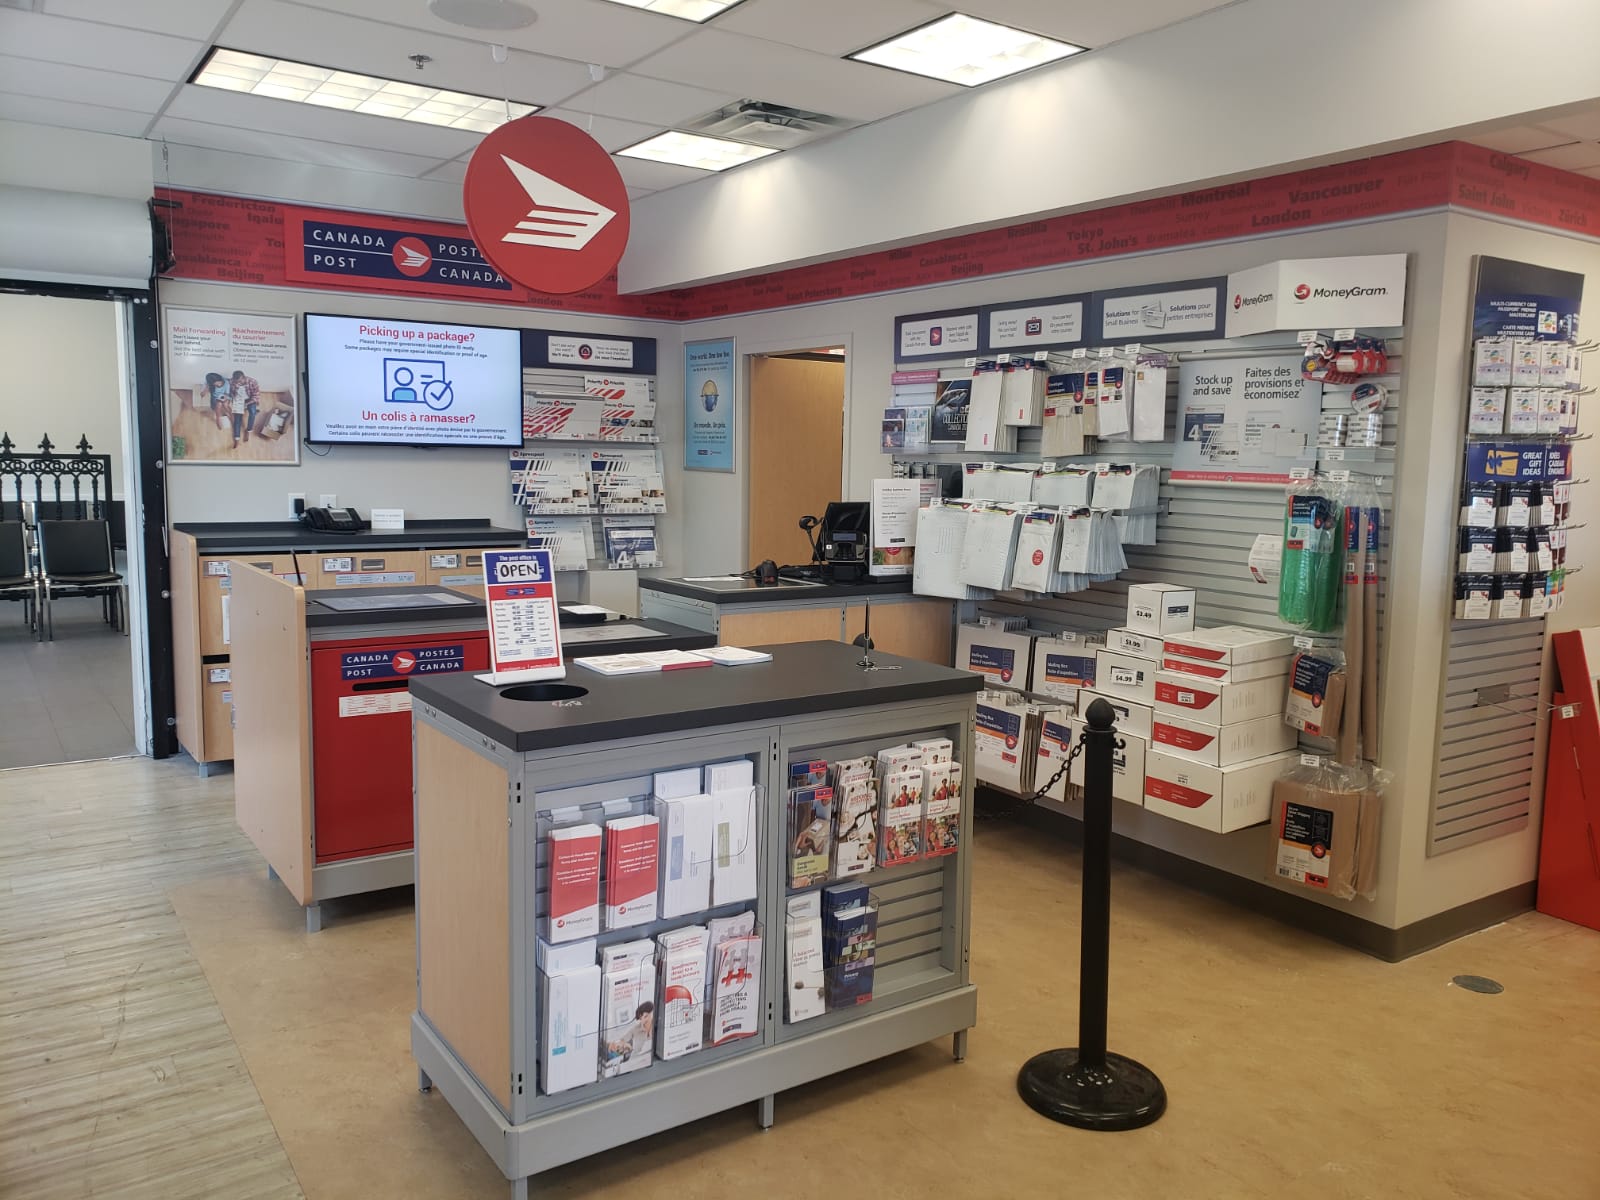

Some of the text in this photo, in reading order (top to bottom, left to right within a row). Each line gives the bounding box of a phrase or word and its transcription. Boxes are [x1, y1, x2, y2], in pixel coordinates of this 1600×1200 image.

[1181, 182, 1251, 207] Montréal
[1288, 178, 1384, 206] Vancouver
[1458, 183, 1488, 204] Saint
[191, 194, 277, 213] Fredericton
[1250, 208, 1312, 229] London
[1066, 227, 1104, 242] Tokyo
[1099, 232, 1138, 252] John's
[312, 229, 484, 259] CANADA POST
[215, 267, 265, 282] Beijing
[313, 254, 505, 285] POST CANADA
[1241, 293, 1273, 307] MoneyGram
[1313, 286, 1387, 299] MoneyGram
[1105, 310, 1131, 318] Solutions
[1169, 304, 1197, 312] Solutions
[359, 325, 475, 344] Picking up a package?
[1245, 366, 1291, 378] Faites des
[1195, 375, 1233, 387] Stock up
[1245, 378, 1305, 391] provisions et
[1192, 385, 1209, 396] and
[361, 410, 476, 424] Un colis à ramasser?
[1188, 424, 1200, 441] 4
[1522, 452, 1543, 460] GREAT
[1522, 468, 1541, 476] IDEAS
[500, 563, 538, 578] OPEN
[346, 649, 455, 664] CANADA POSTES
[346, 662, 460, 677] POST CANADA
